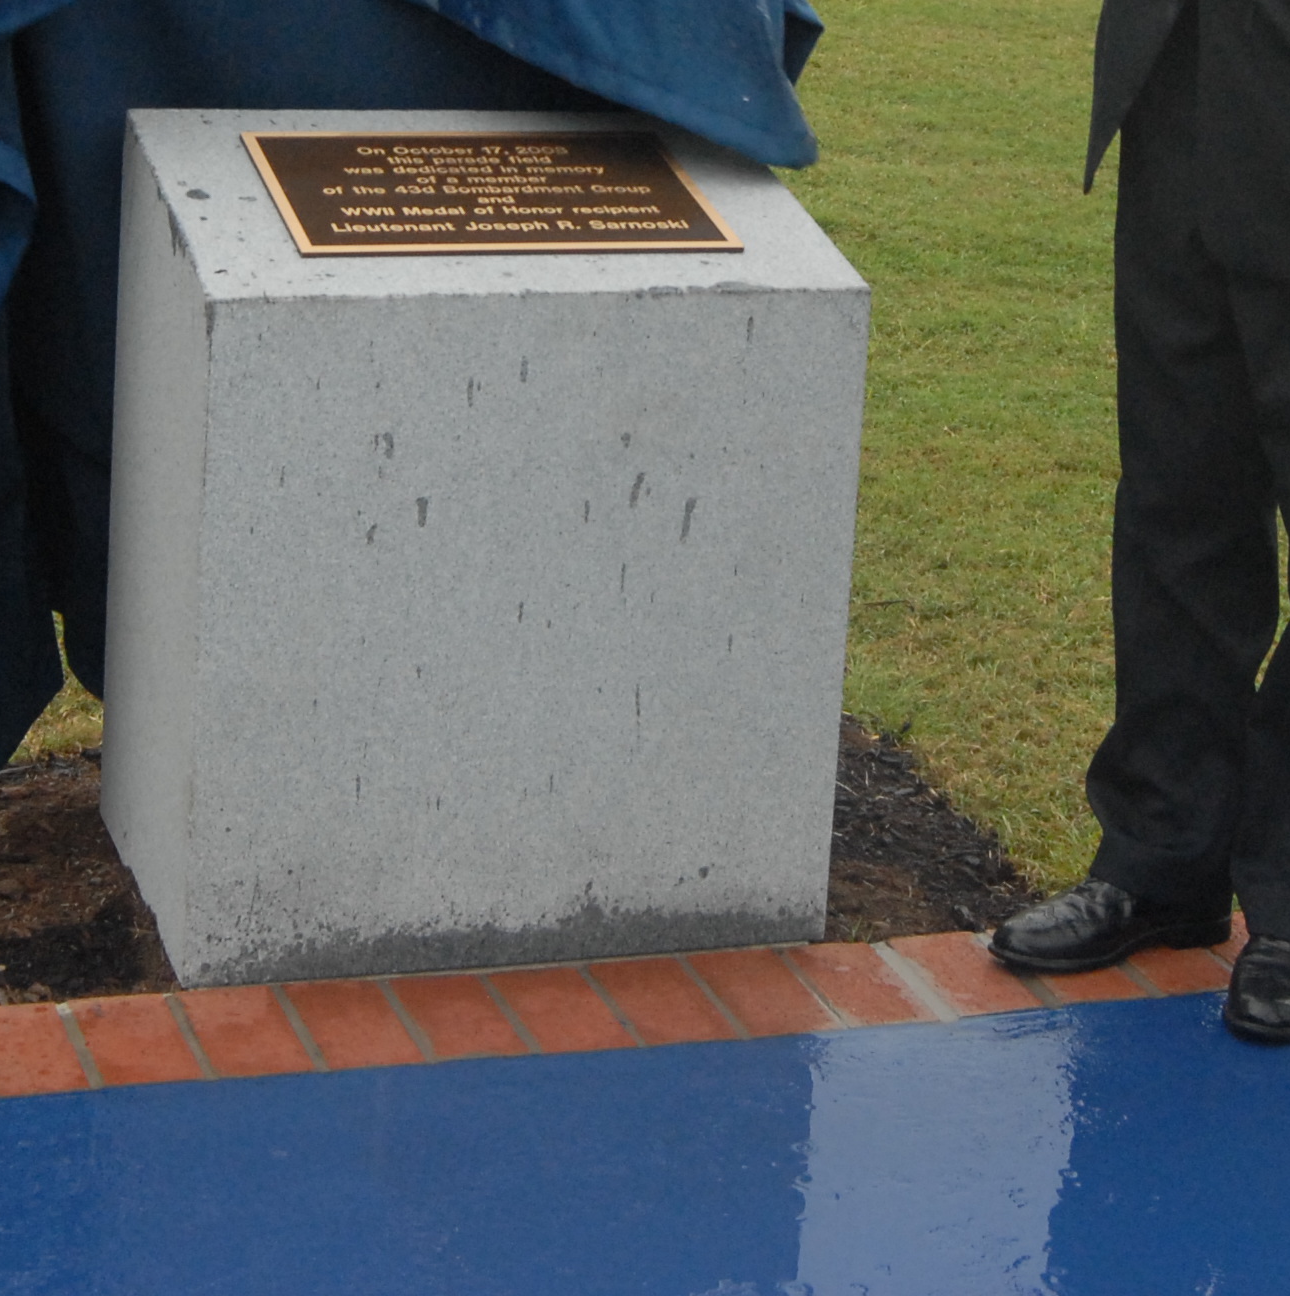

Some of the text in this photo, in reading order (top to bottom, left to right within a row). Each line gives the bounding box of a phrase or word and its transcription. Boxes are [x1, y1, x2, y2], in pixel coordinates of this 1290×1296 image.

[357, 146, 385, 155] On
[393, 146, 473, 155] October
[387, 155, 552, 166] this parade field
[343, 165, 605, 175] was dedicated in memory
[416, 175, 436, 184] of
[467, 175, 548, 184] member
[323, 184, 651, 195] of the 43d Bombardment Group
[477, 195, 516, 204] and
[340, 204, 661, 216] WWII Medal of Honor recipient
[331, 219, 690, 233] Lieutenant Joseph R. Sarnoski
